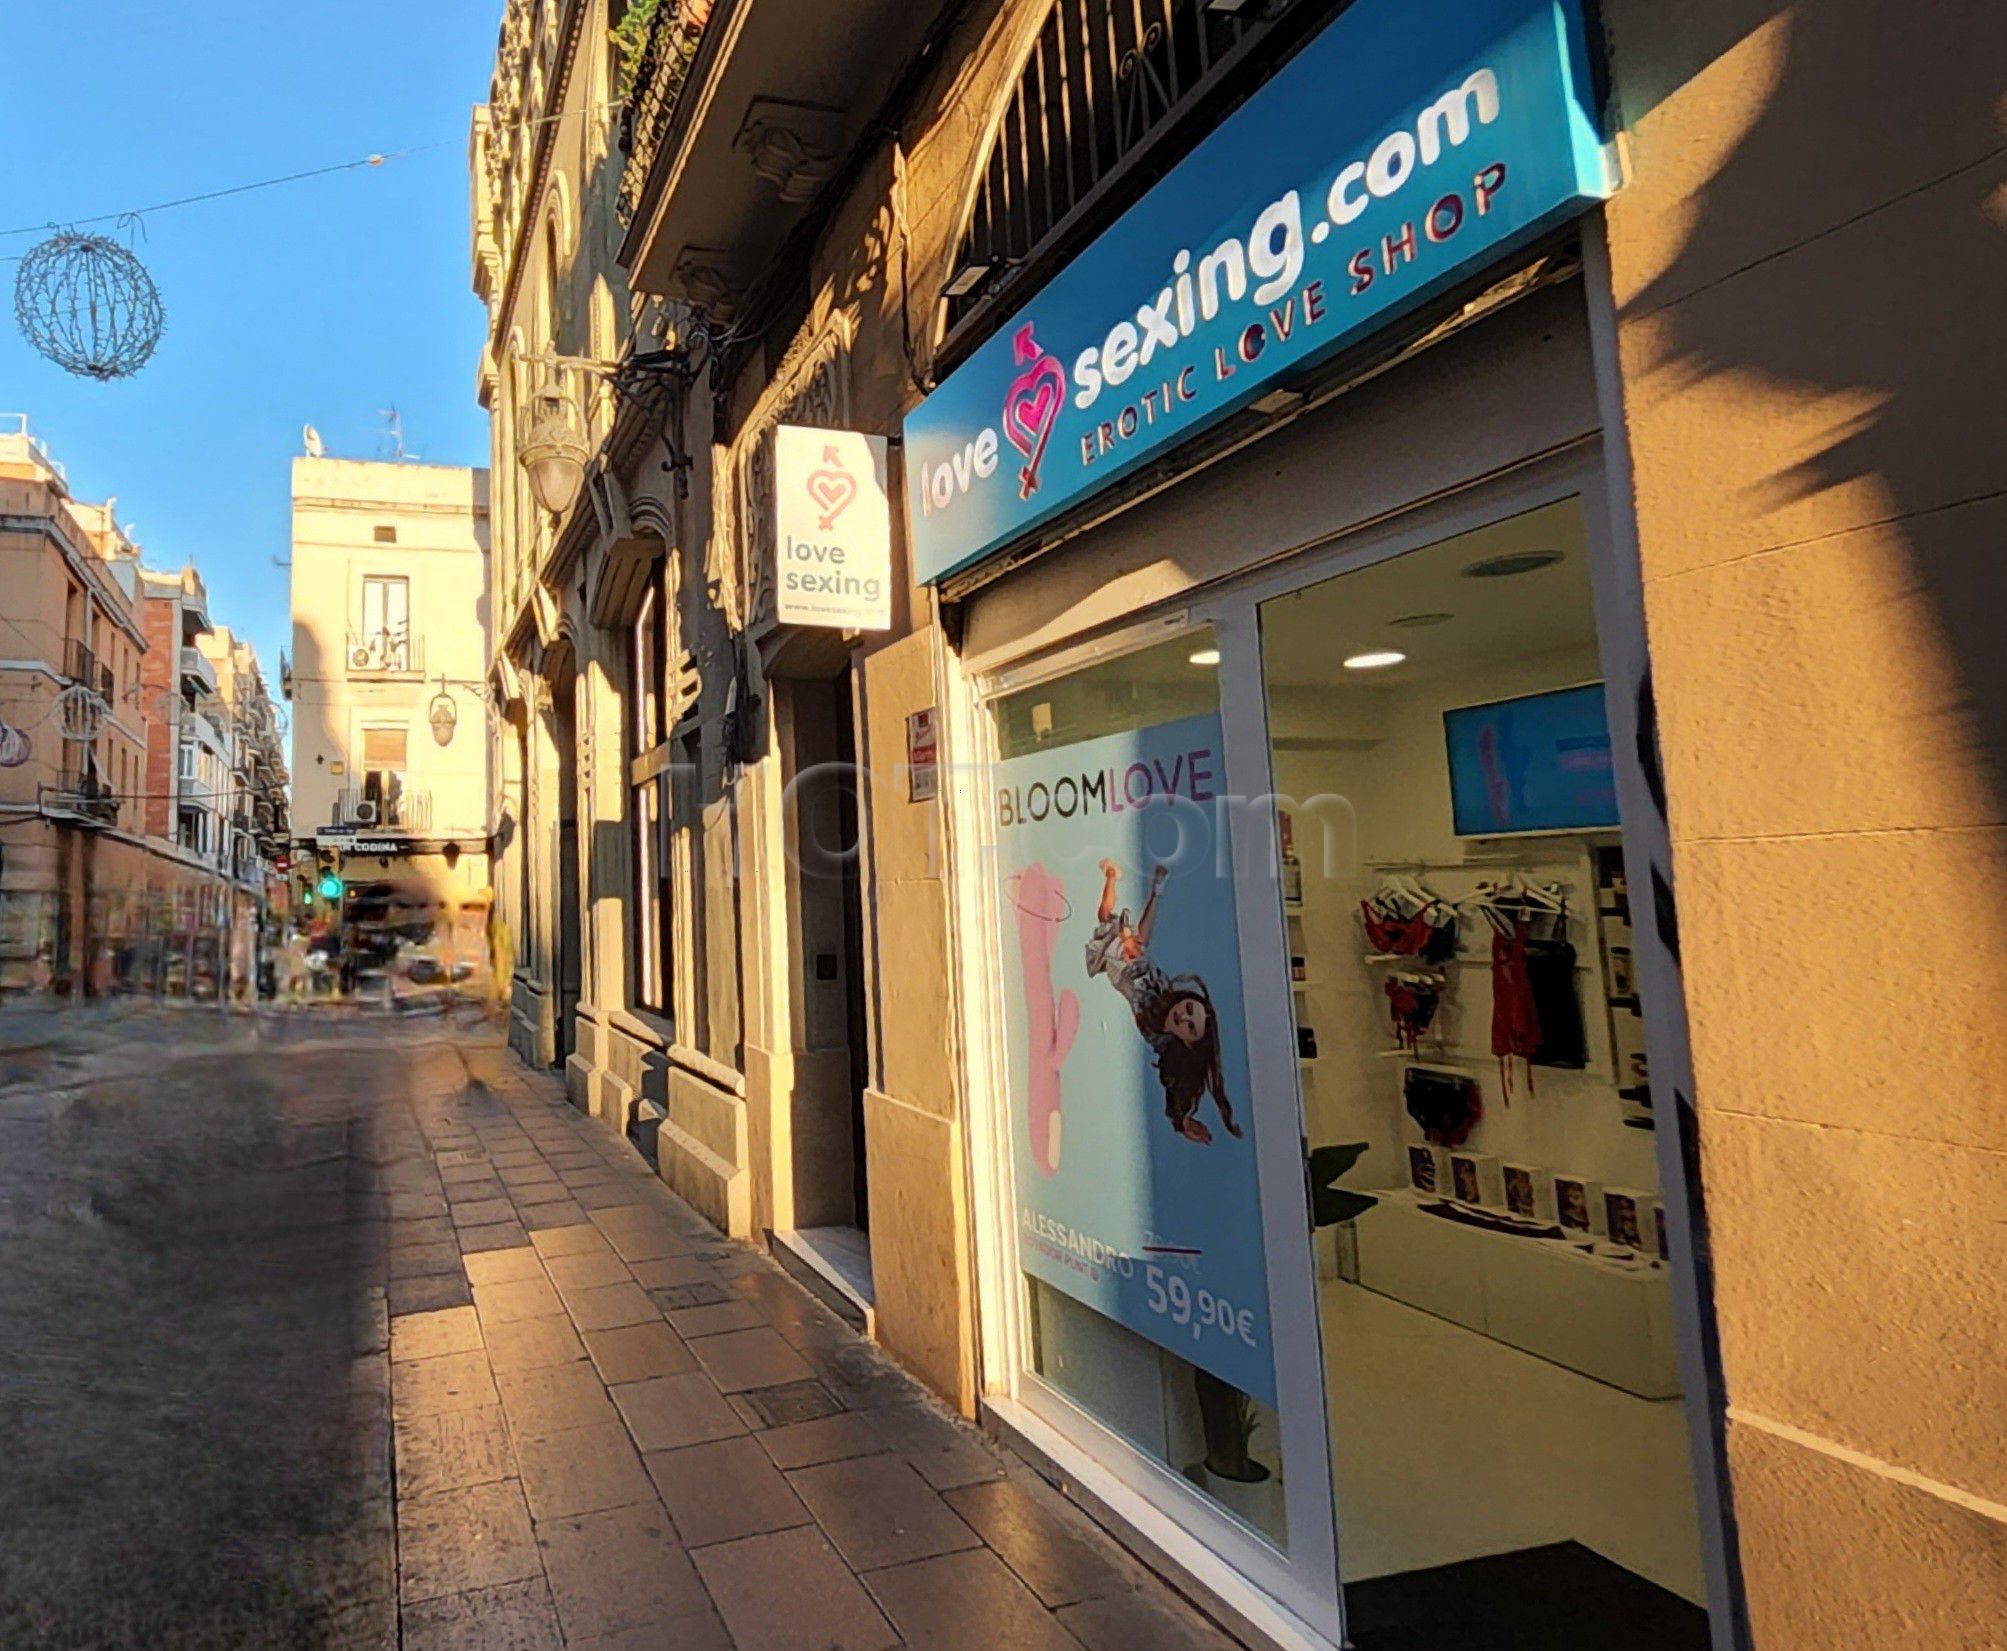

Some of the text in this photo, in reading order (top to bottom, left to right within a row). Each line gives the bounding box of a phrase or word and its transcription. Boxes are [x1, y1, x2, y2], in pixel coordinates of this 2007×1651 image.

[921, 66, 1500, 516] love sexing.com
[1081, 161, 1507, 467] EROTIC LOVE SHOP
[786, 535, 845, 564] love
[786, 570, 880, 602] sexing
[998, 749, 1214, 827] BLOOMLOVE
[1021, 1207, 1135, 1280] ALESSANDRO
[1145, 1264, 1256, 1347] 59,90€
